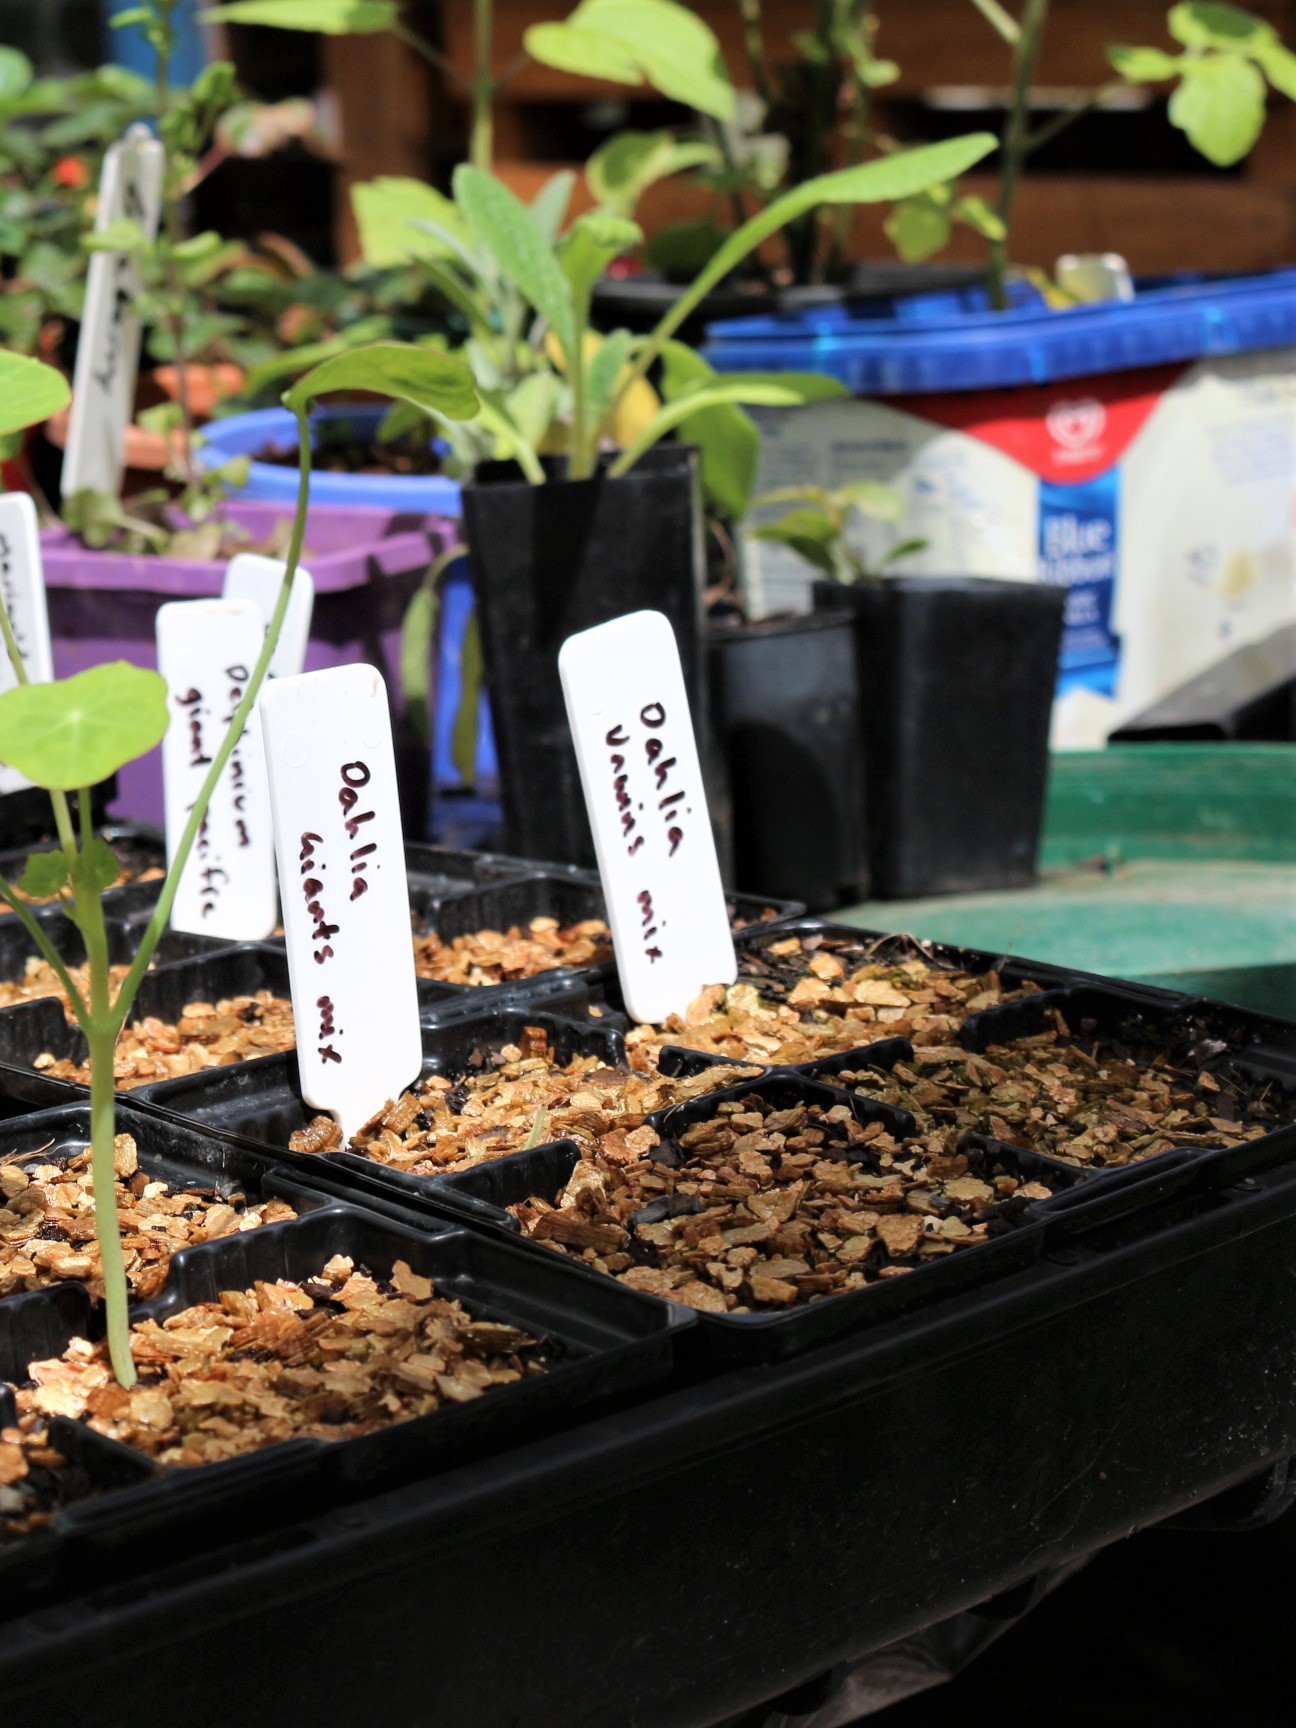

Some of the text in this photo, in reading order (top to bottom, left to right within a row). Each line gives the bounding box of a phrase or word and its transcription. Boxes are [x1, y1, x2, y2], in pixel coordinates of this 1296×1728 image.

[176, 688, 212, 767] giant
[640, 702, 692, 857] Dahlia
[338, 761, 380, 902] Dahlia
[638, 890, 666, 963] mix
[316, 995, 344, 1064] mix
